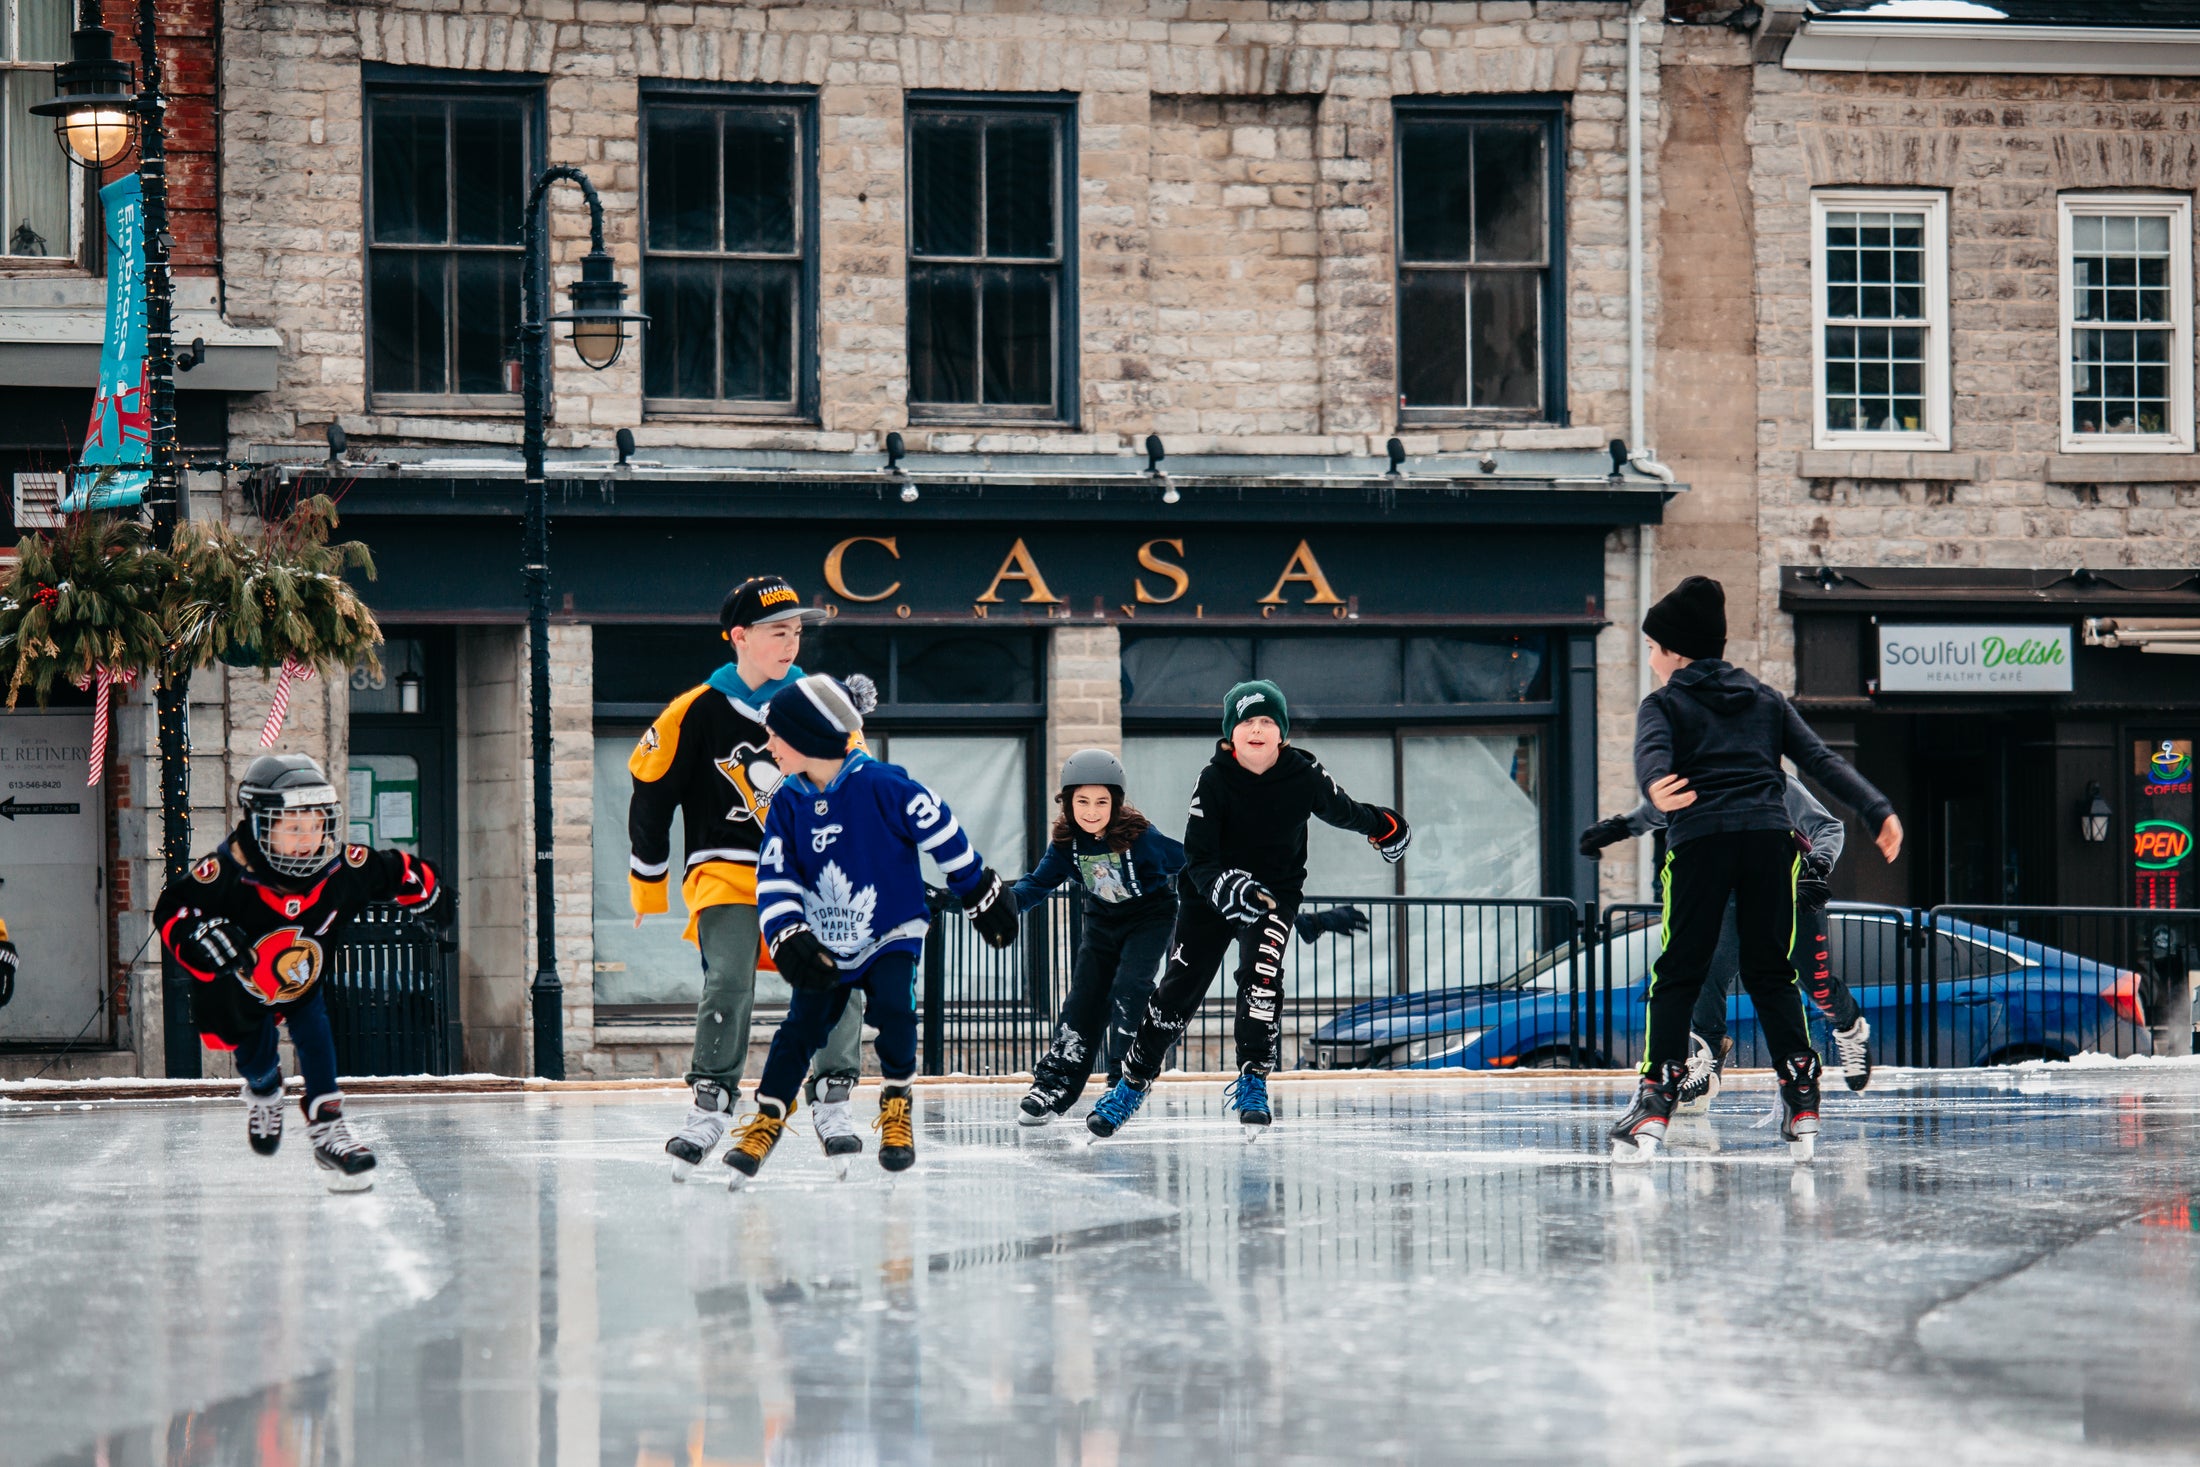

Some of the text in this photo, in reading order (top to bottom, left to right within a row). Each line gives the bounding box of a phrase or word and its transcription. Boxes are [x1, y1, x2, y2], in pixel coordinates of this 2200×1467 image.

[113, 208, 126, 345] the Season
[823, 536, 1347, 604] CASA
[1885, 636, 2065, 668] Soulful Delish
[1927, 670, 2023, 682] HEALTHY CAFÉ
[16, 746, 91, 761] REFINERY
[8, 781, 62, 789] 613-546-8420
[54, 805, 69, 814] King
[811, 906, 865, 922] TORONTO
[821, 921, 857, 931] MAPLE
[821, 932, 859, 942] LEAFS
[1248, 913, 1289, 1022] JORDAN
